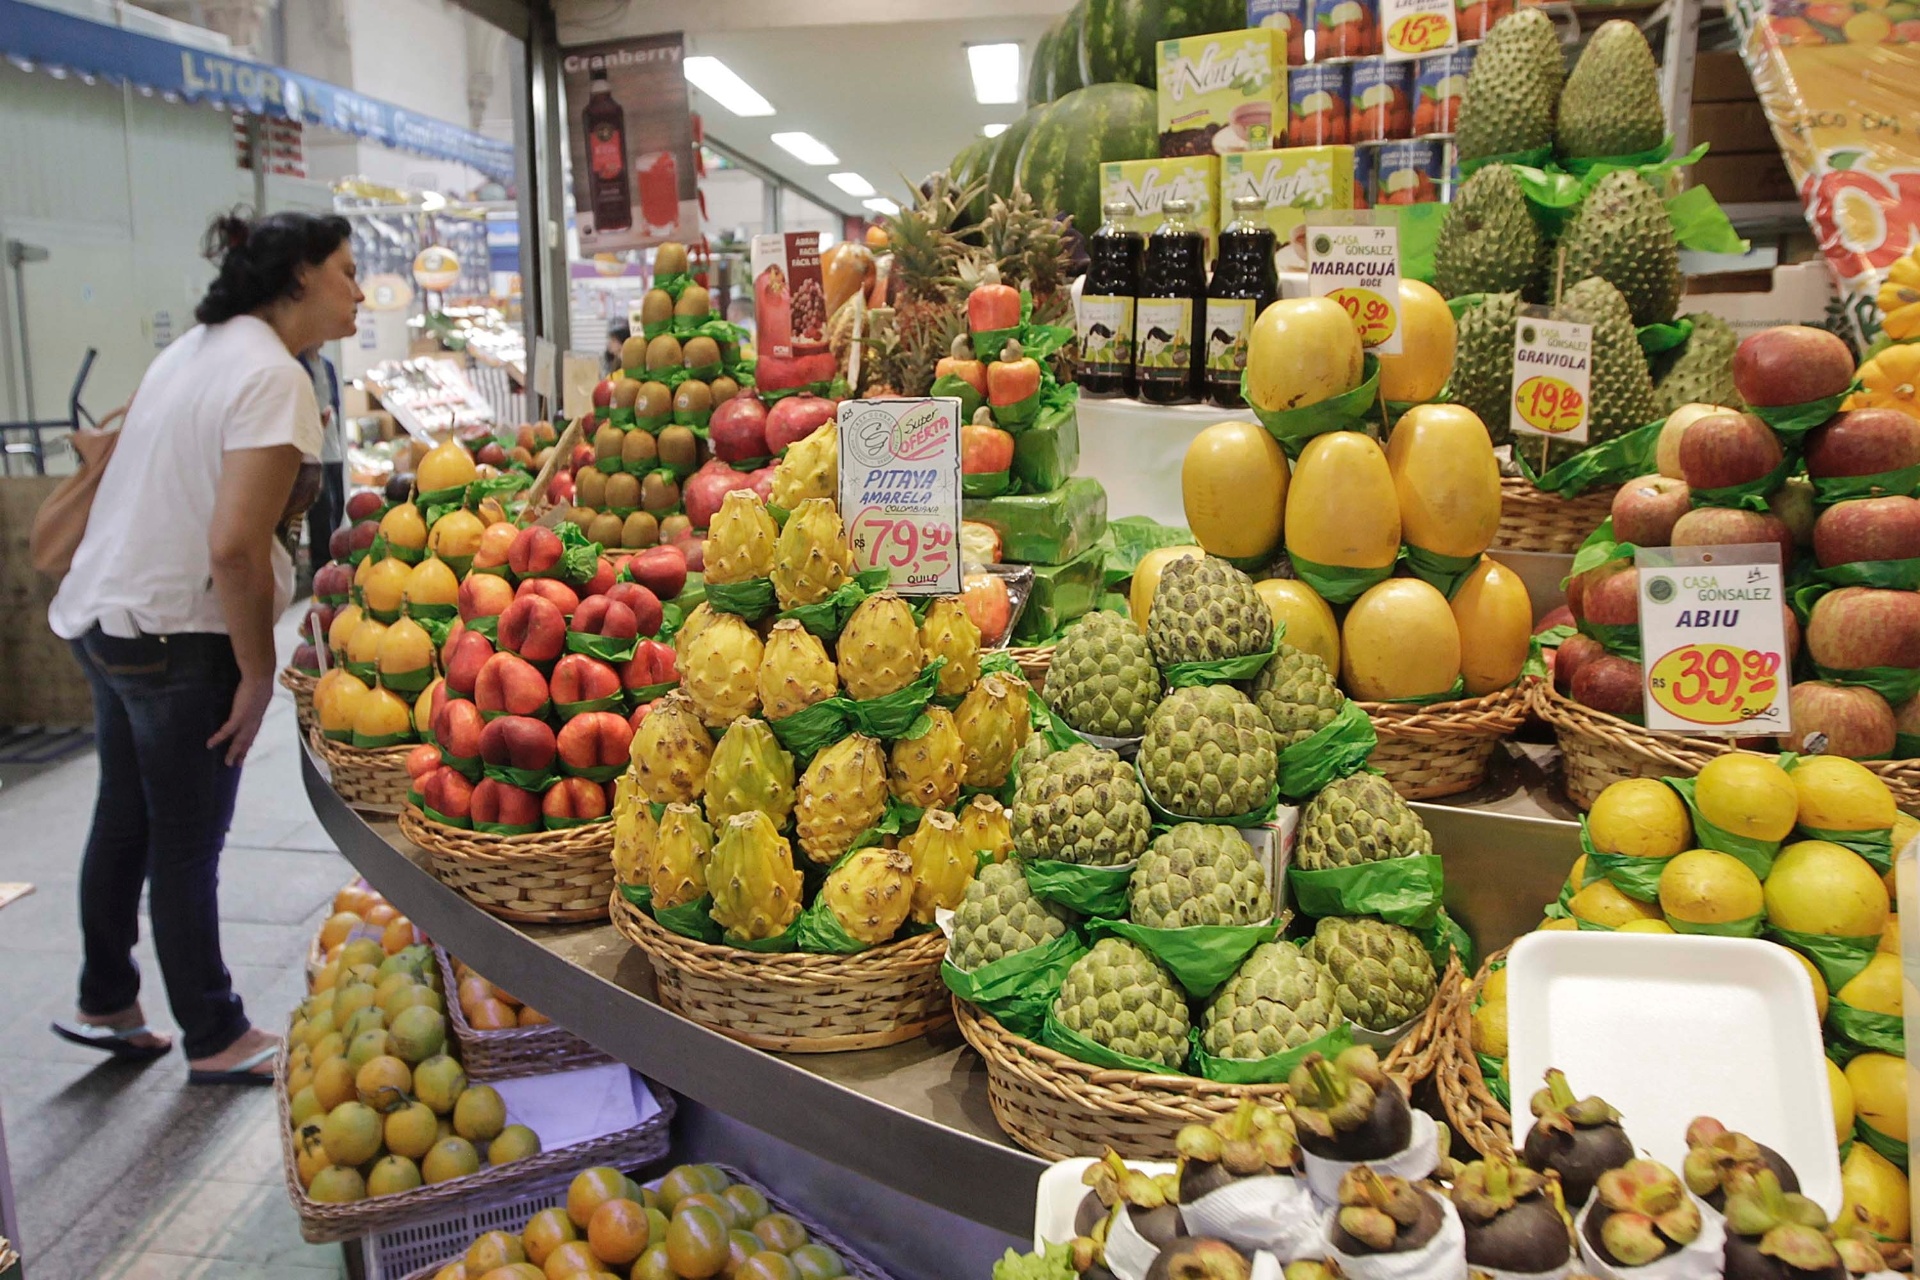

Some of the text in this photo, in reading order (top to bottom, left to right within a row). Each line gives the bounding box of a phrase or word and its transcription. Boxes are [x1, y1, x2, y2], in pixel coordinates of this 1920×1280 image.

[563, 45, 682, 73] Cranberry
[1177, 48, 1240, 96] Noni
[1336, 235, 1359, 245] CASA
[1345, 245, 1393, 256] GONSALEZ
[1311, 258, 1395, 276] MARACUJÁ
[1360, 278, 1382, 287] DOCE
[1517, 349, 1587, 370] GRAVIOLA
[905, 408, 939, 434] Super
[901, 416, 949, 454] OFERTA
[864, 469, 937, 489] PITAYA
[859, 491, 932, 505] AMARELA
[885, 504, 940, 514] COLOMBIANA
[907, 574, 939, 586] QUILO
[1683, 576, 1719, 589] CASA
[1698, 588, 1772, 601] GONSALEZ
[1675, 609, 1740, 628] ABIU
